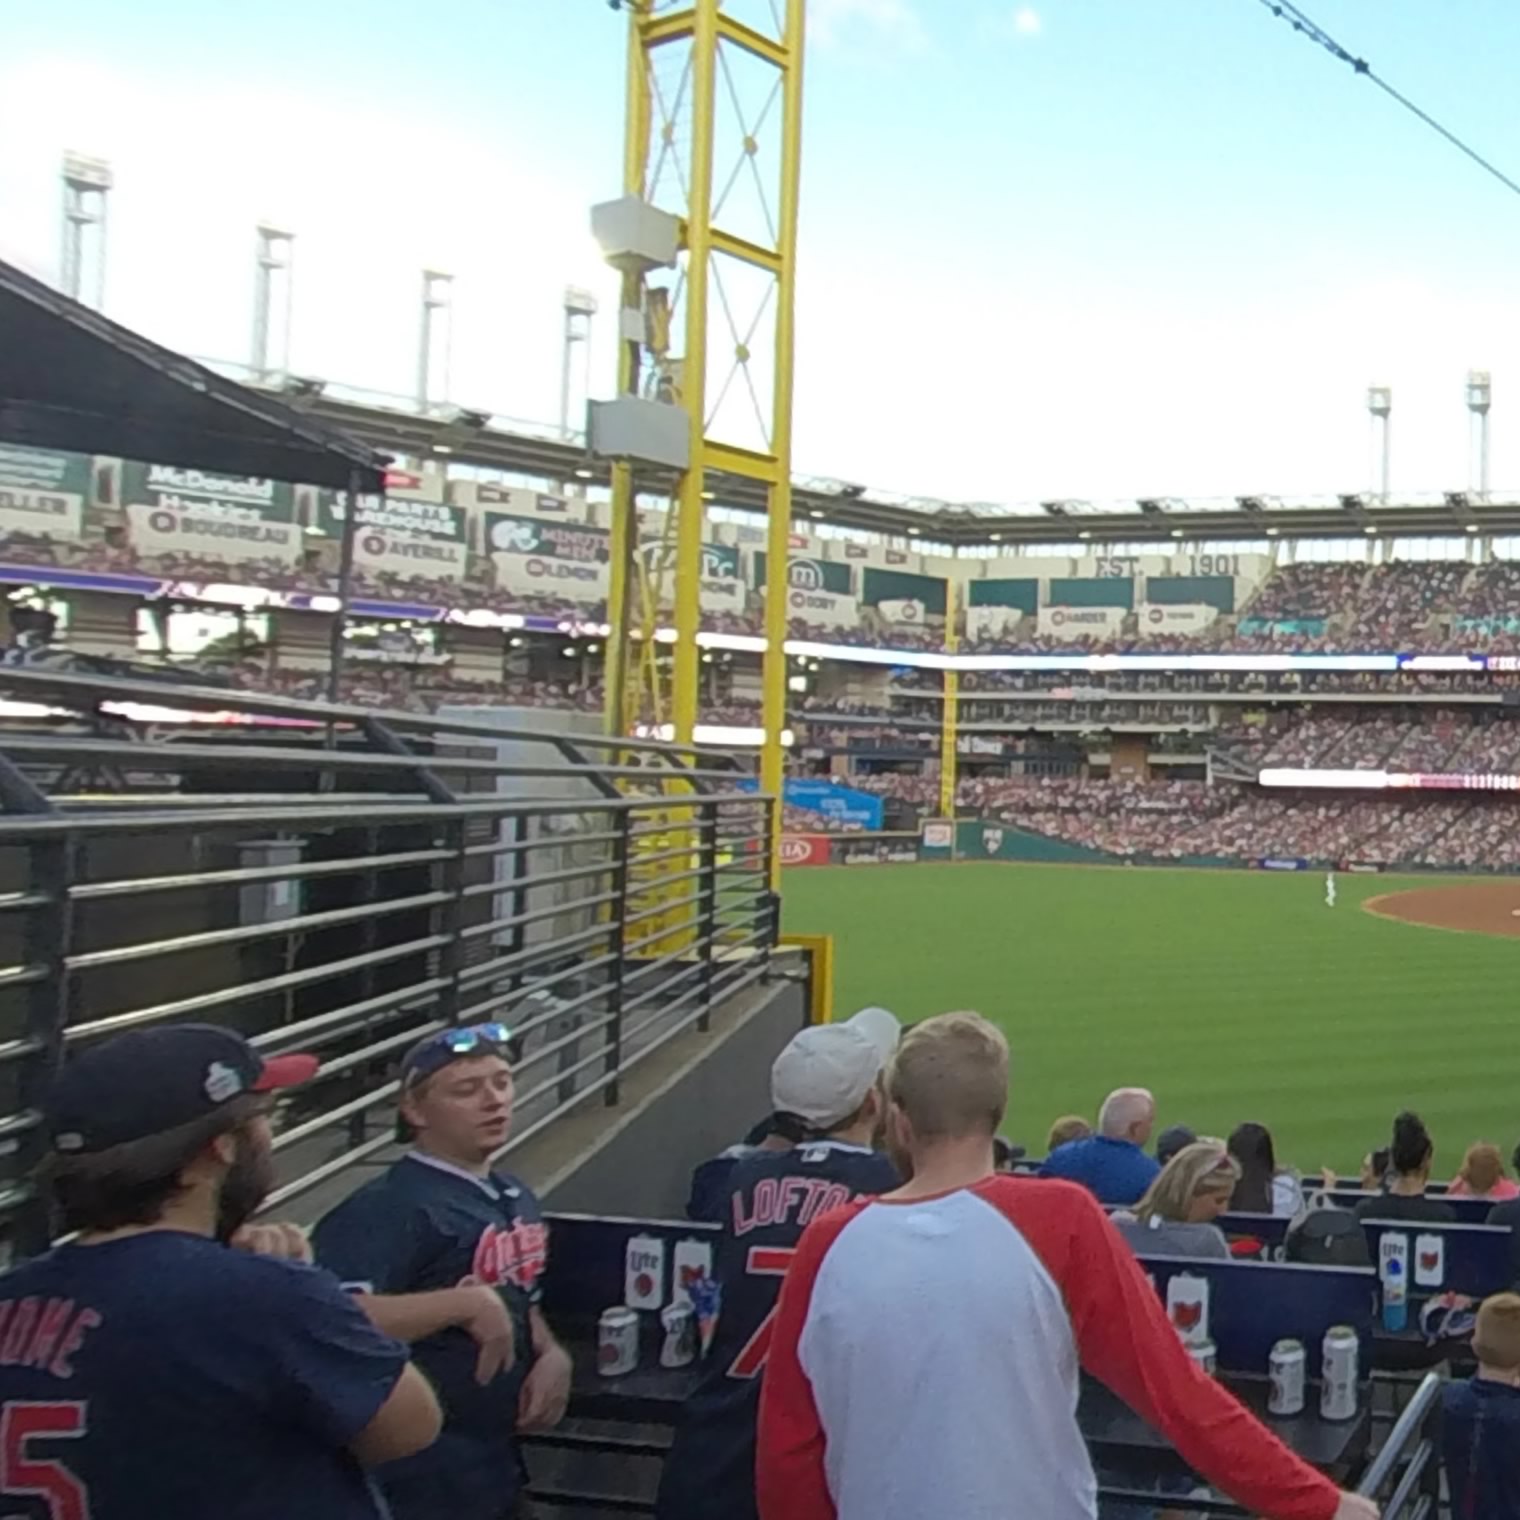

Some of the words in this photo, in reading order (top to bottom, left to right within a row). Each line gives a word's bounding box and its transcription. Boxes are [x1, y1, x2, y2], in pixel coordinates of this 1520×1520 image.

[181, 516, 289, 545] BOUDREAU
[390, 540, 458, 563] AVERILL
[1096, 556, 1144, 577] EST.
[1189, 554, 1240, 577] 1901
